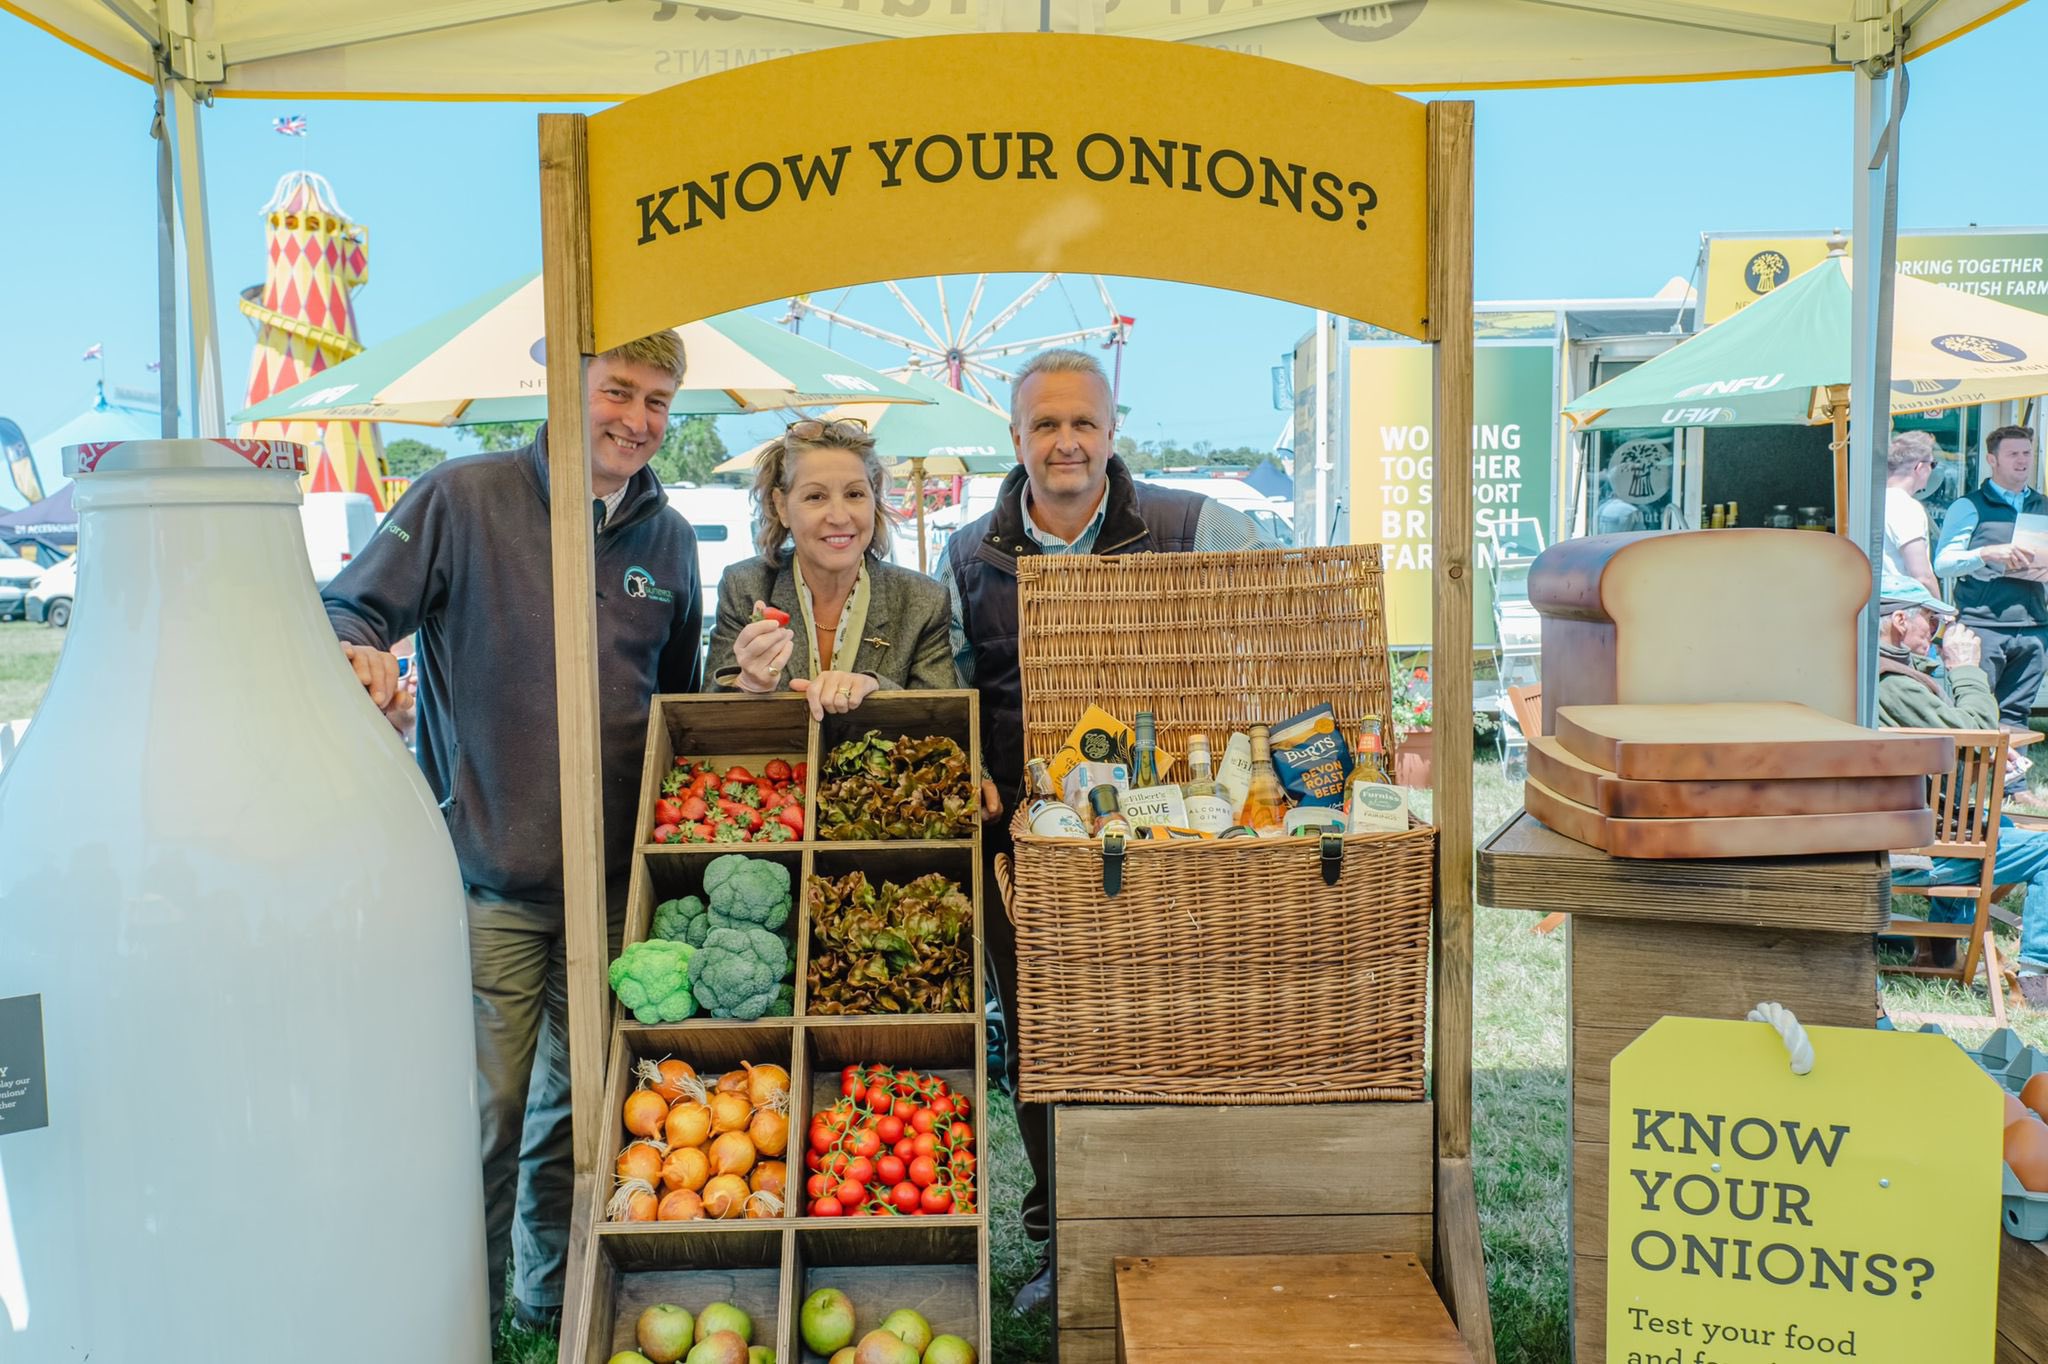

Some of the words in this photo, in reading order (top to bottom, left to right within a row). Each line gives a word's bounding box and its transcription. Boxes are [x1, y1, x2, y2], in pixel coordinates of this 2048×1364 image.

[637, 146, 851, 246] KNOW
[869, 132, 1057, 187] YOUR
[1077, 133, 1377, 230] ONIONS?
[1895, 260, 1953, 275] RKING
[1958, 258, 2043, 274] TOGETHER
[1703, 373, 1785, 396] NFU
[1380, 424, 1521, 451] WOING
[1379, 454, 1521, 481] TOGHER
[1379, 484, 1409, 505] TO
[1382, 508, 1519, 539] BRSH
[1383, 543, 1519, 569] FARNG
[1301, 760, 1343, 782] DEVON
[1305, 771, 1345, 790] ROAST
[1314, 783, 1344, 799] BEEF
[1127, 803, 1170, 817] OLIVE
[15, 1077, 31, 1086] our
[1632, 1108, 1850, 1167] KNOW
[1630, 1169, 1813, 1226] YOUR
[1631, 1230, 1935, 1300] ONIONS?
[1628, 1307, 1693, 1336] Test
[1702, 1323, 1776, 1346] your
[1785, 1324, 1857, 1356] food
[1627, 1348, 1682, 1364] and
